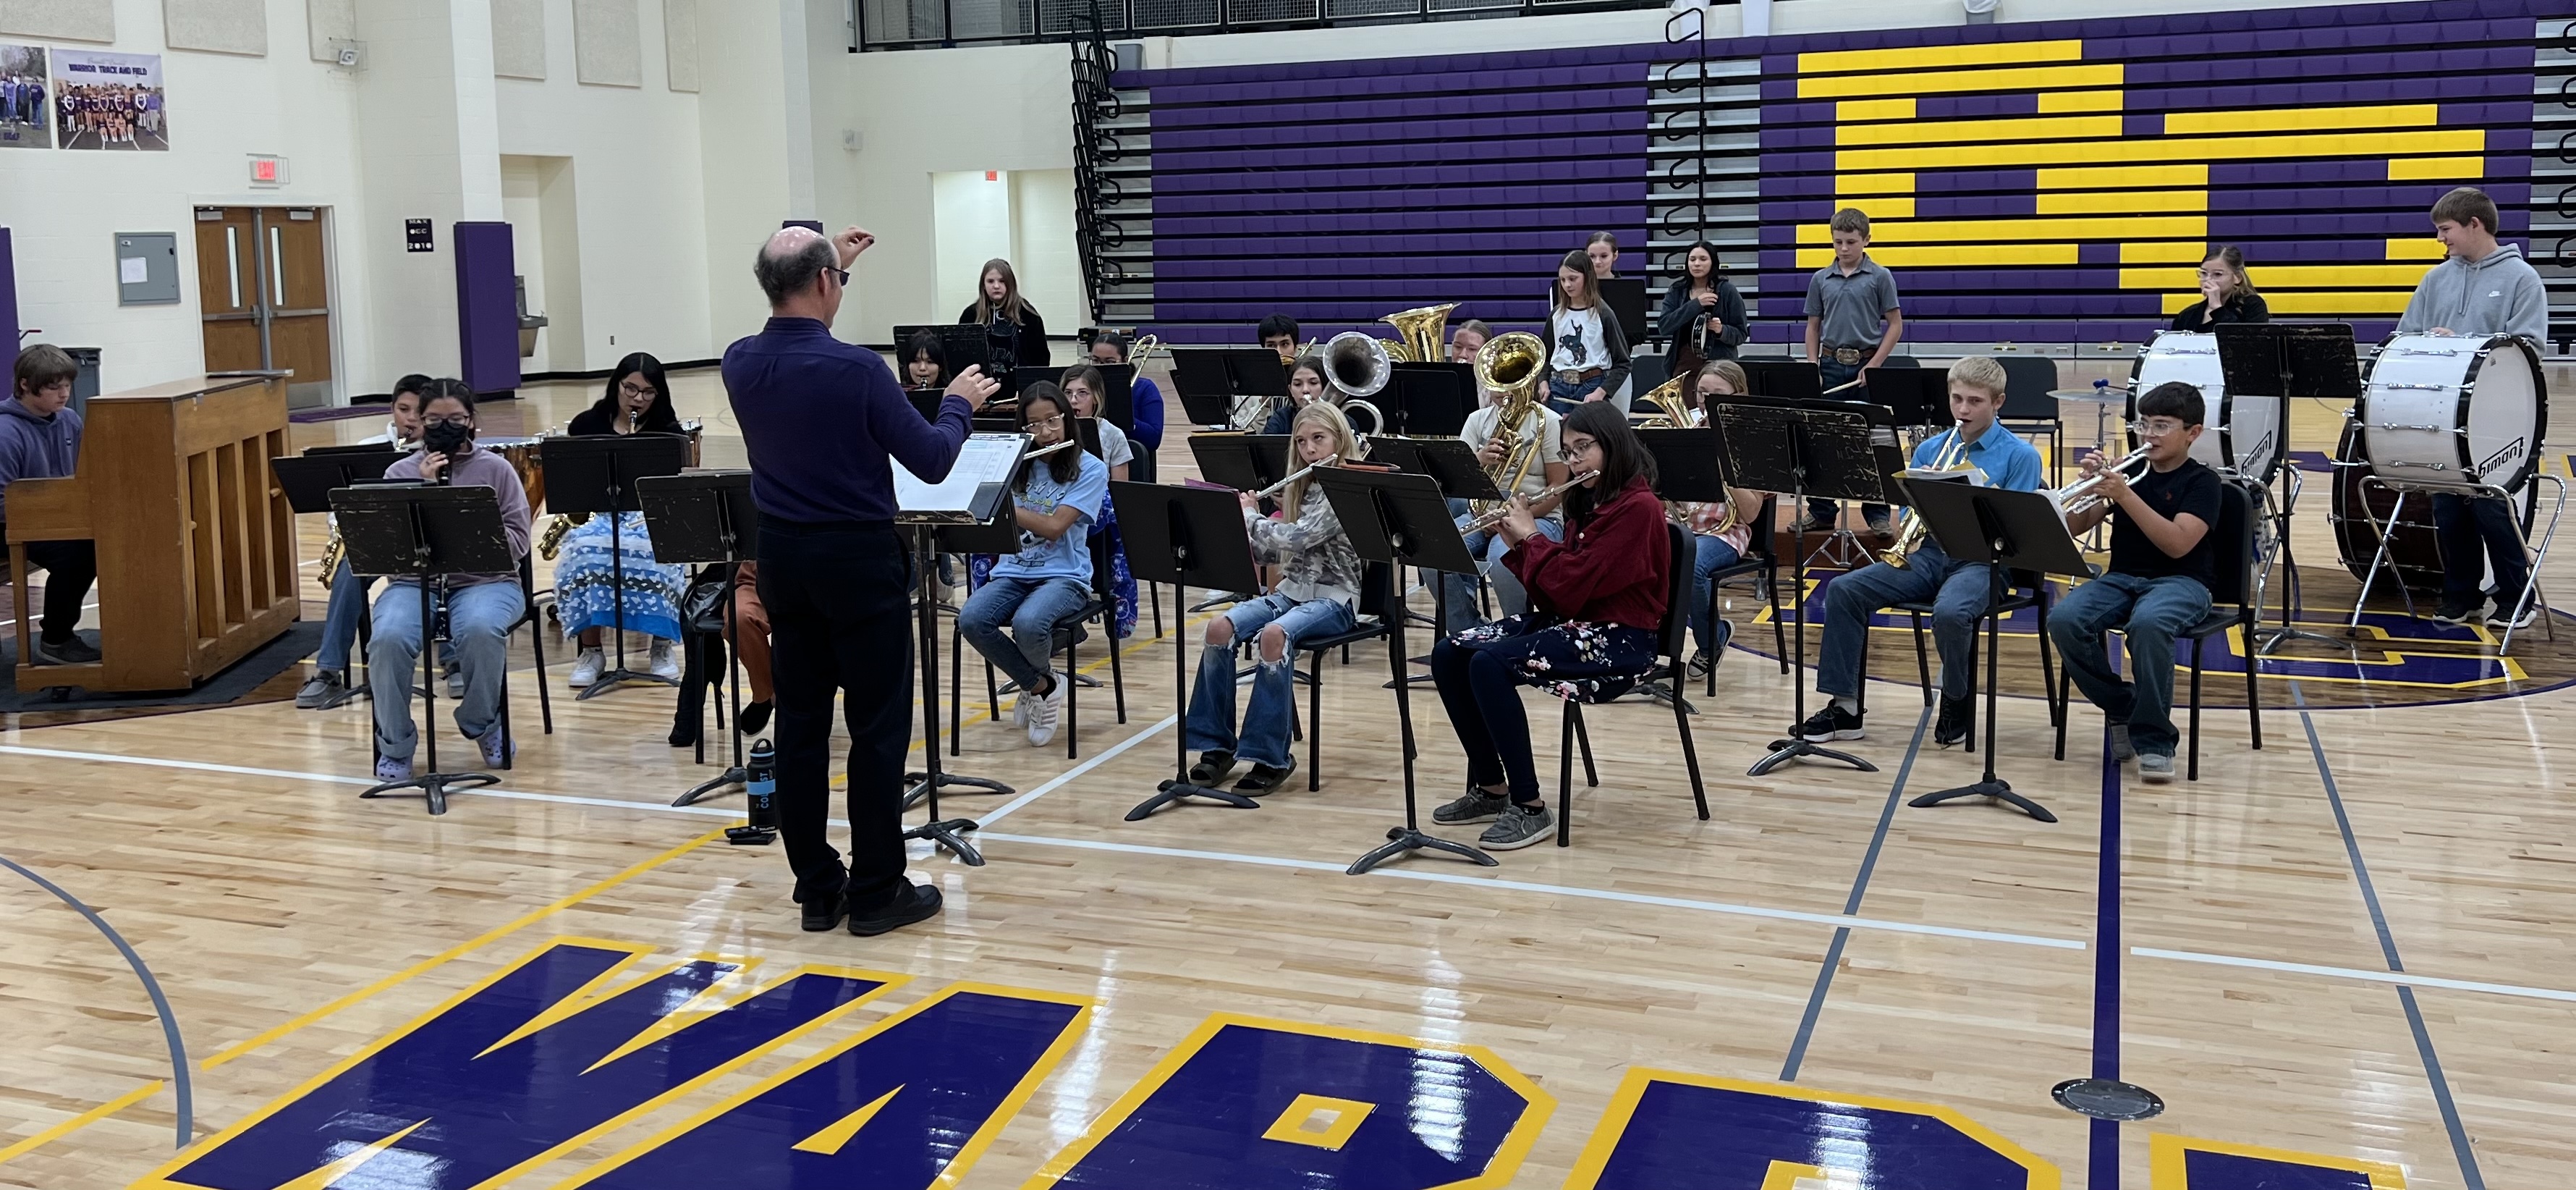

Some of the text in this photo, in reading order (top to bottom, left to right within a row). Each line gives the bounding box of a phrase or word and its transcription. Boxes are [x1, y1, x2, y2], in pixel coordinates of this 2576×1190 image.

[69, 64, 96, 72] WARRIOR
[2478, 437, 2523, 478] Ludwig
[760, 772, 769, 809] COLST
